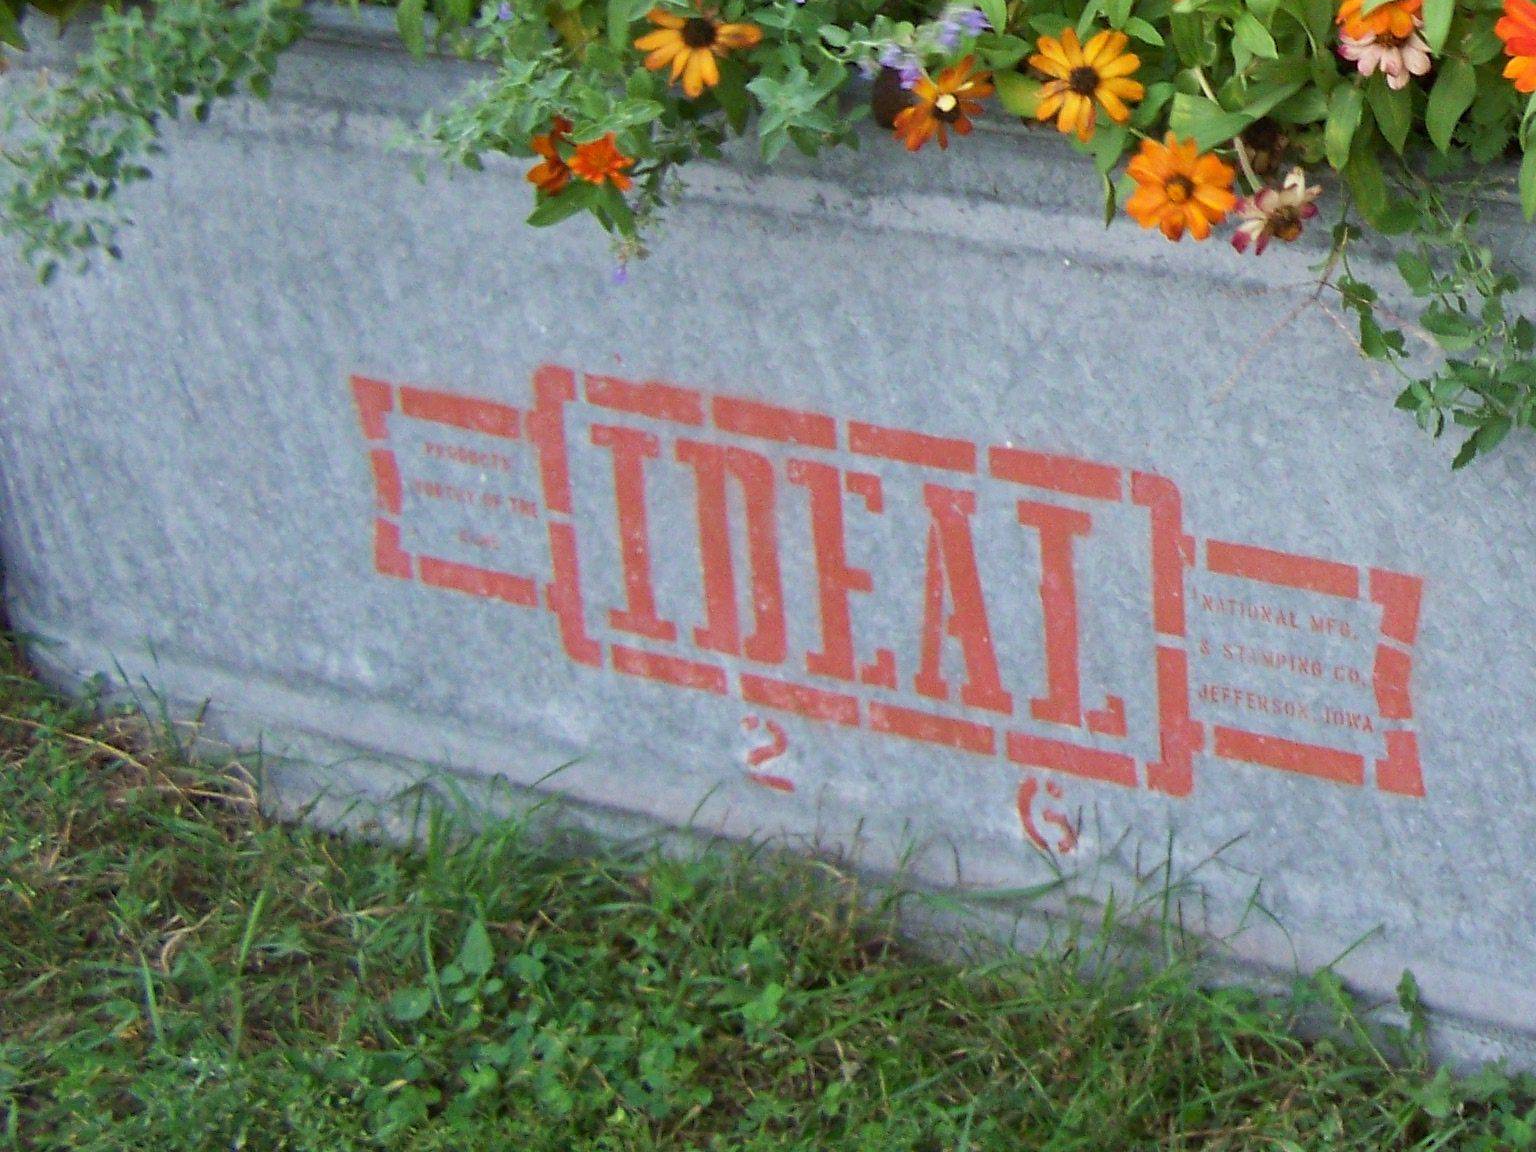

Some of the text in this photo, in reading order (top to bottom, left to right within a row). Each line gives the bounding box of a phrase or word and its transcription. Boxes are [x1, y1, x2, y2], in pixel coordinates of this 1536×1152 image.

[590, 422, 1128, 738] IDEAL
[1202, 594, 1299, 630] NATIONAL
[1324, 705, 1374, 734] IOWA
[740, 716, 796, 793] 2
